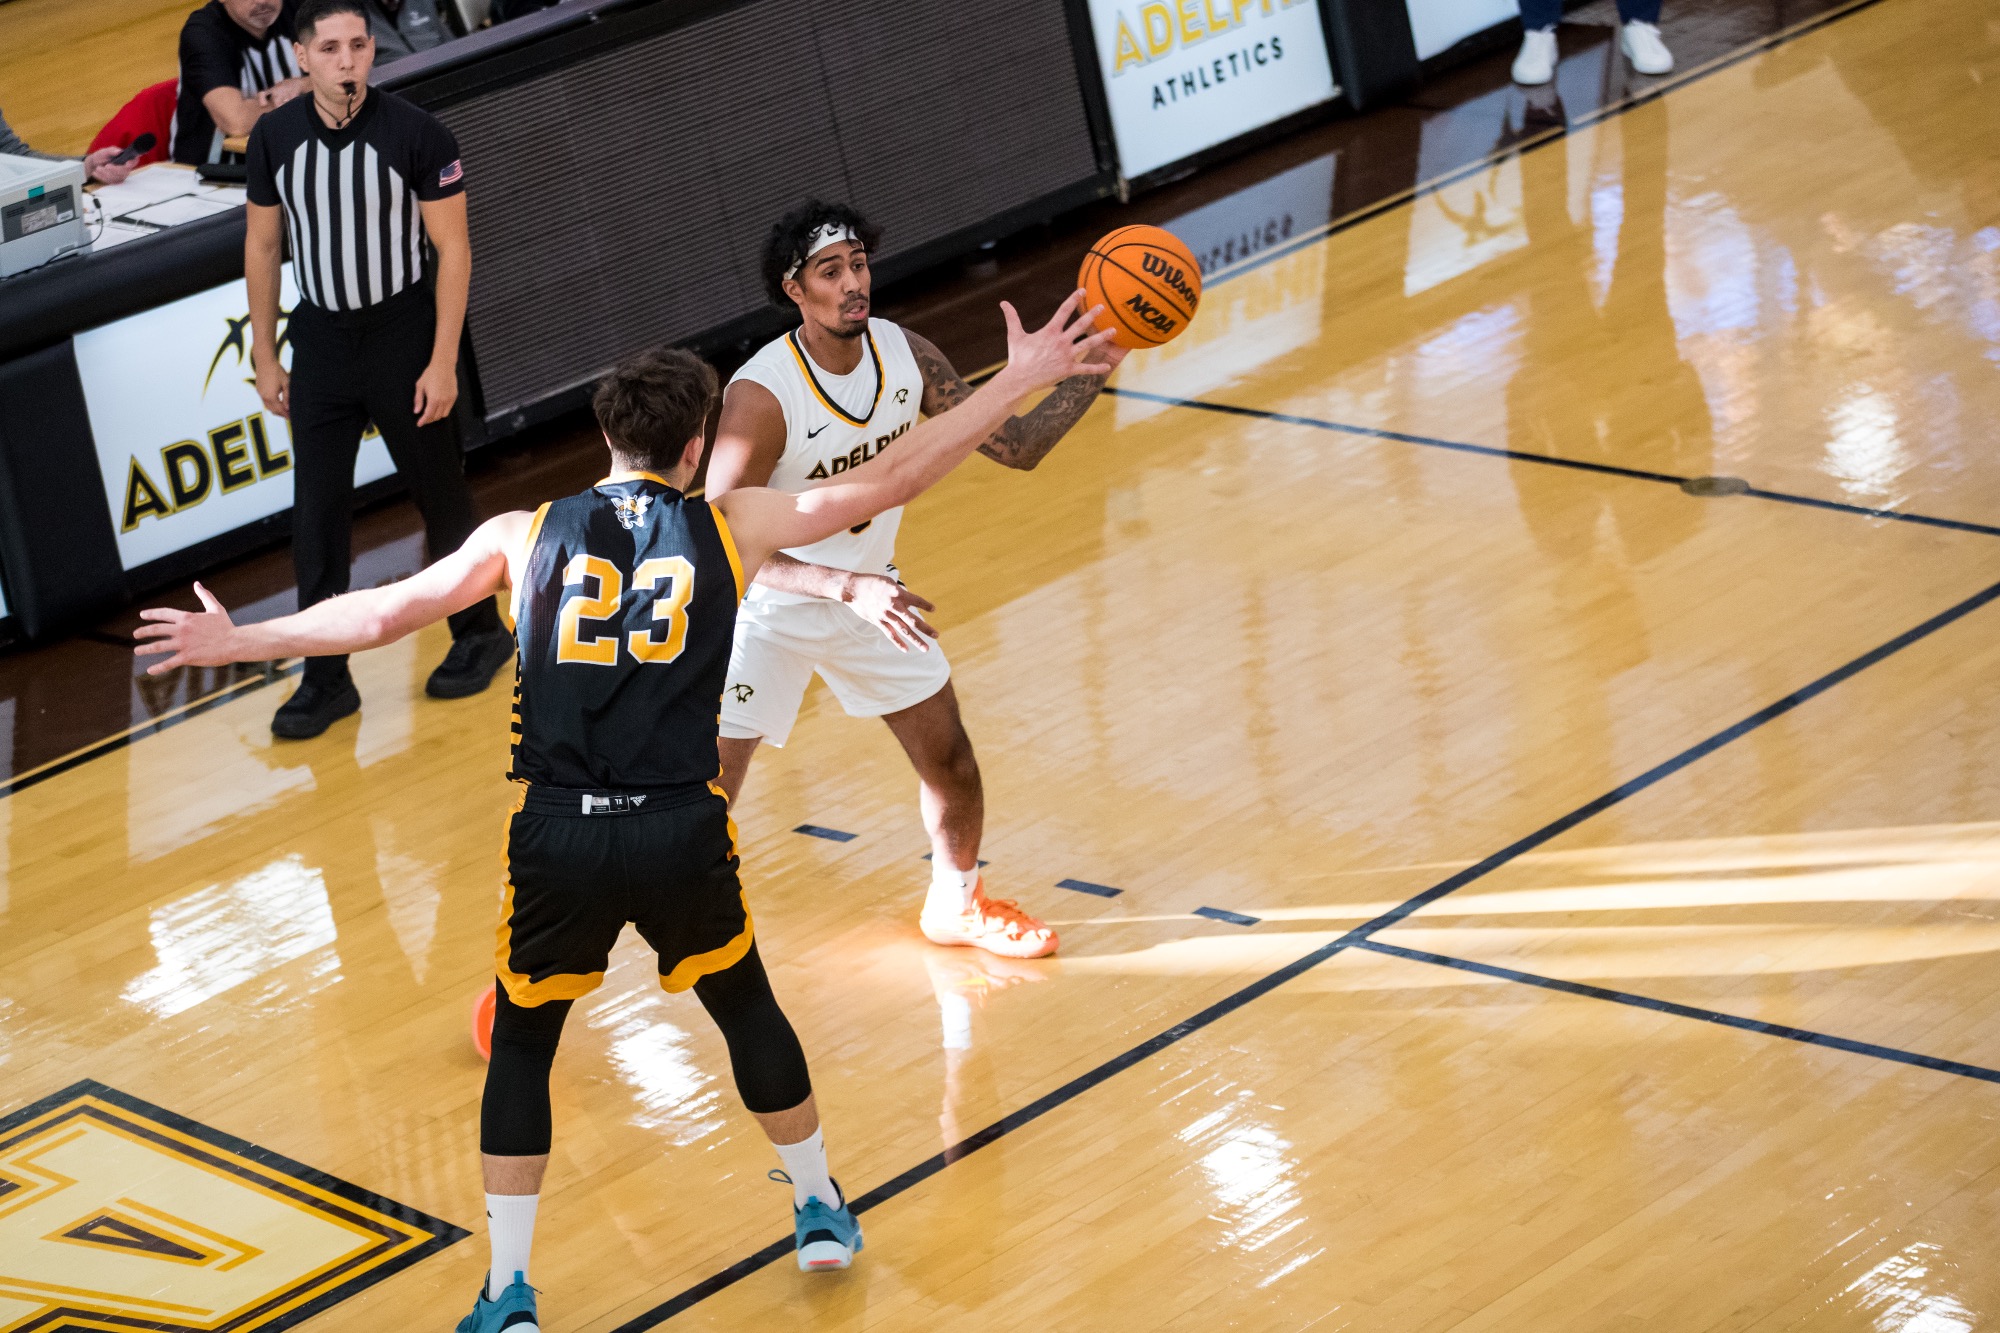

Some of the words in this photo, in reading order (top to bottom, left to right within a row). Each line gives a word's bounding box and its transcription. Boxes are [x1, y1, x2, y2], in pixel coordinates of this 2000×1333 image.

[1112, 0, 1309, 76] ADELP
[1152, 36, 1284, 110] ATHLETICS
[1126, 293, 1177, 334] NCAA
[1142, 251, 1199, 312] Wilson
[121, 412, 381, 534] ADEL
[557, 553, 695, 667] 23
